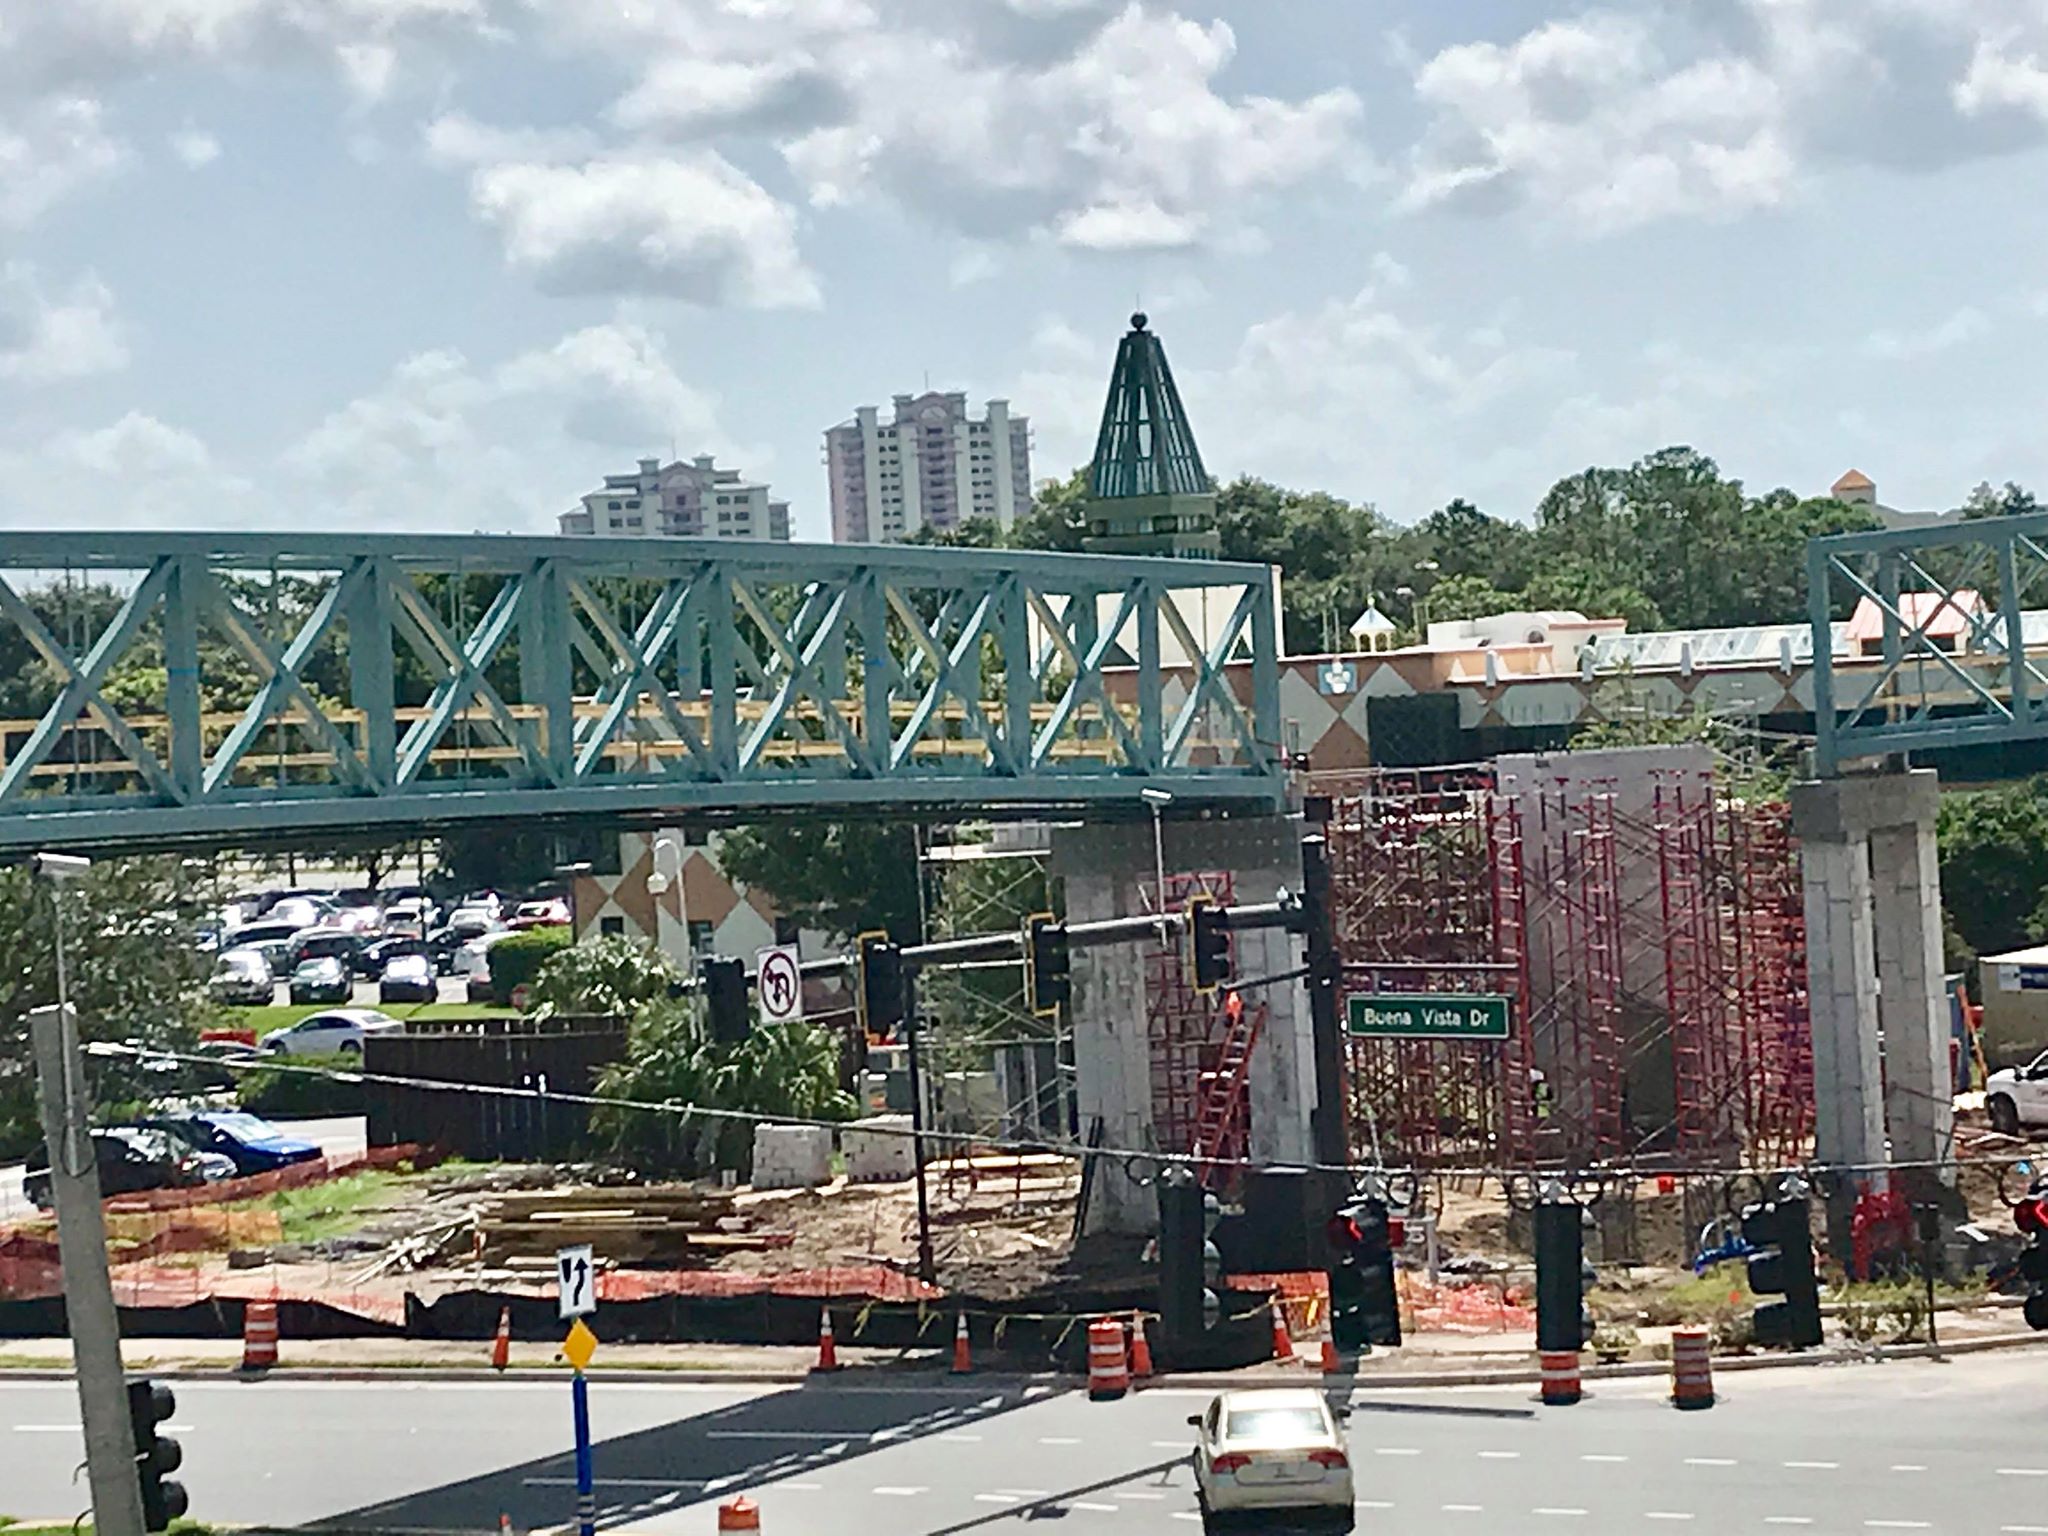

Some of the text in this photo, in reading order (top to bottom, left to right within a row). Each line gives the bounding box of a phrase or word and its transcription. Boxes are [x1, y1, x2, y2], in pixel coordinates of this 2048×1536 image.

[1363, 1007, 1490, 1027] Buena Vista Dr
